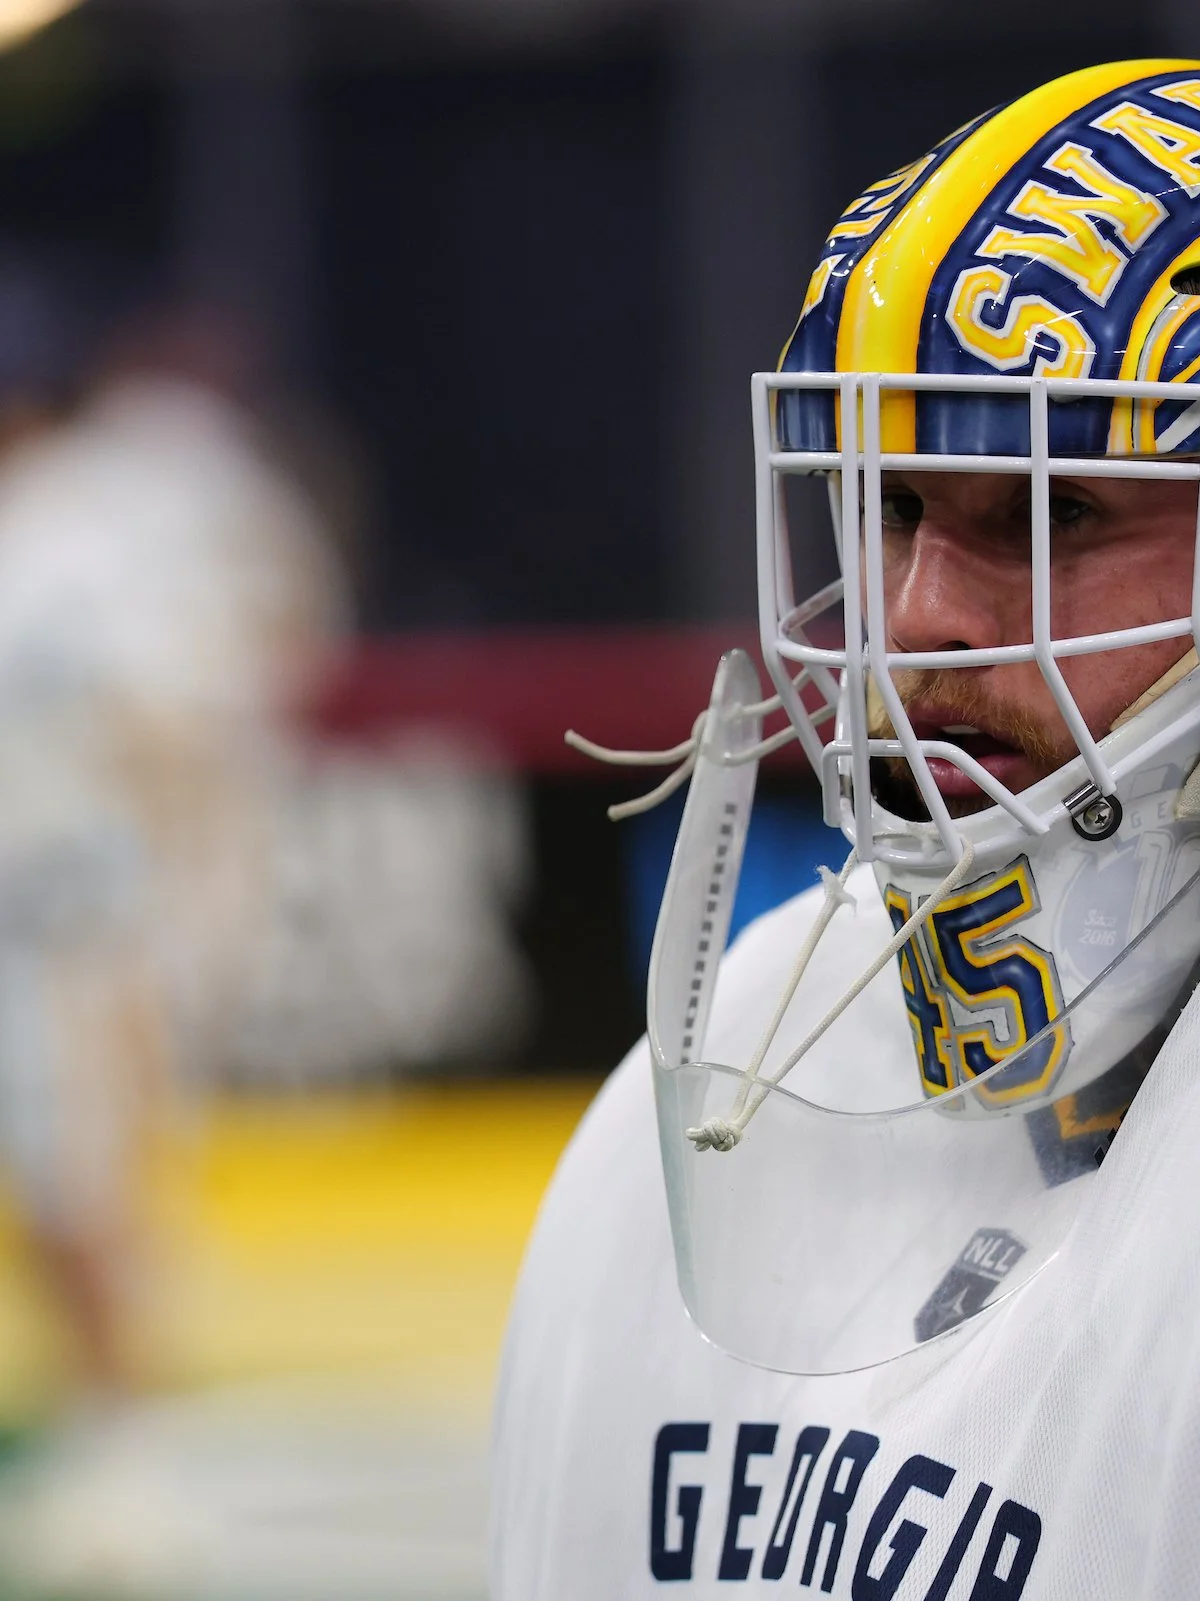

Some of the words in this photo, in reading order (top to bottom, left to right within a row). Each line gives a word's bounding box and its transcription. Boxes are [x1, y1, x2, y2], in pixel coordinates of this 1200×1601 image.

[1078, 928, 1118, 946] 2016
[963, 1236, 1018, 1273] NLL
[650, 1422, 1043, 1601] GEORGIA
